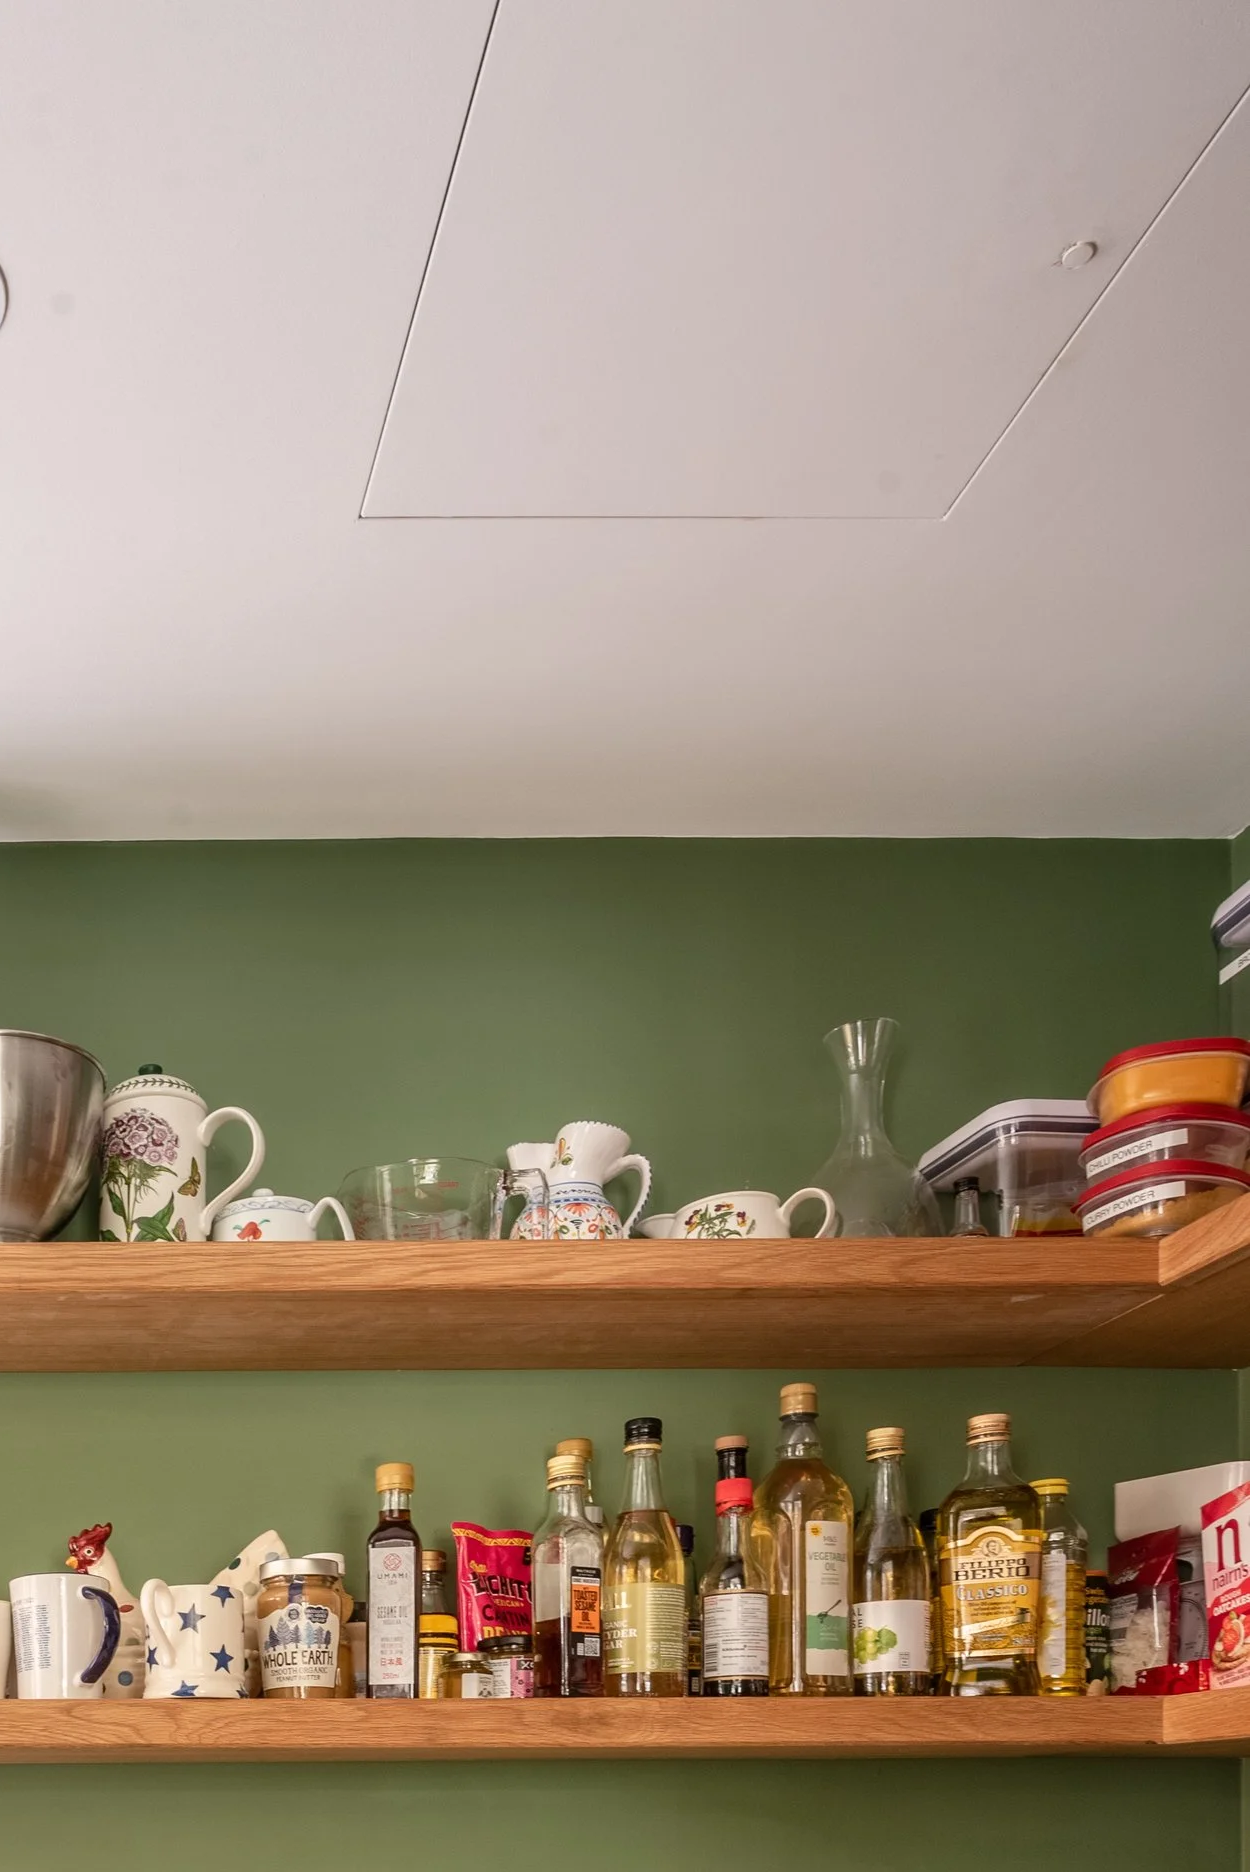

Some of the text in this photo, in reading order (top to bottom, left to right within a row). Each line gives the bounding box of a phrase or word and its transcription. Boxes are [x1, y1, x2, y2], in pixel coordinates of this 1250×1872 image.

[1088, 1140, 1153, 1174] CHILLI POWDER
[1086, 1190, 1155, 1226] CURRY POWDER
[808, 1552, 847, 1562] VEGETABLE
[824, 1562, 837, 1571] OIL
[959, 1558, 1027, 1570] FILIPPO
[954, 1566, 1030, 1581] BERIO
[1212, 1564, 1249, 1591] nairn's
[573, 1589, 598, 1601] TOASTED
[574, 1600, 596, 1612] SESAME
[581, 1611, 590, 1622] OIL
[262, 1650, 334, 1669] WHOLE EARTH
[270, 1666, 328, 1677] SMOOTH ORGANIC
